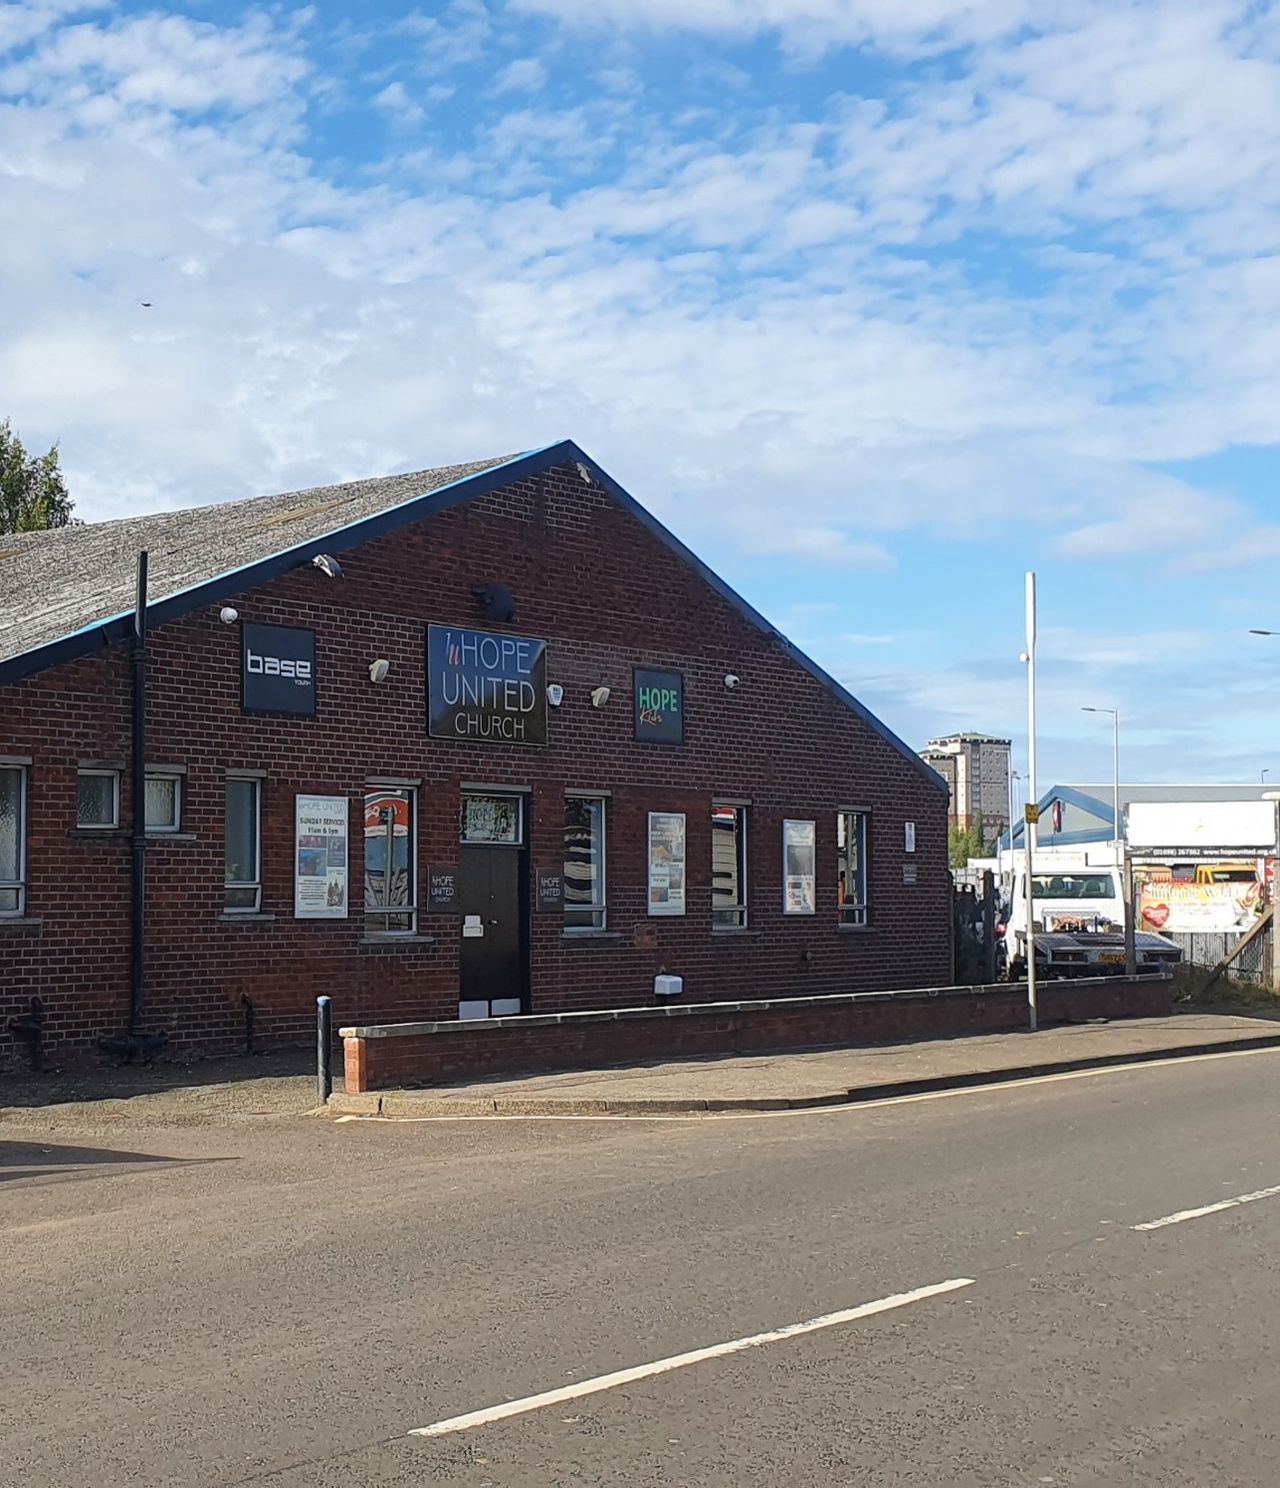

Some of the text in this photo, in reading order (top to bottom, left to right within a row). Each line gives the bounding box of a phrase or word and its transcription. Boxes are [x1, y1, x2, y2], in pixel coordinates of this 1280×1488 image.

[247, 648, 312, 679] base
[461, 633, 531, 674] HOPE
[442, 671, 536, 713] UNITED
[639, 687, 678, 712] HOPE
[455, 712, 525, 739] CHURCH
[639, 704, 663, 727] Kids
[431, 887, 455, 896] UNITED
[439, 875, 455, 887] HOPE
[540, 888, 561, 897] UNITED
